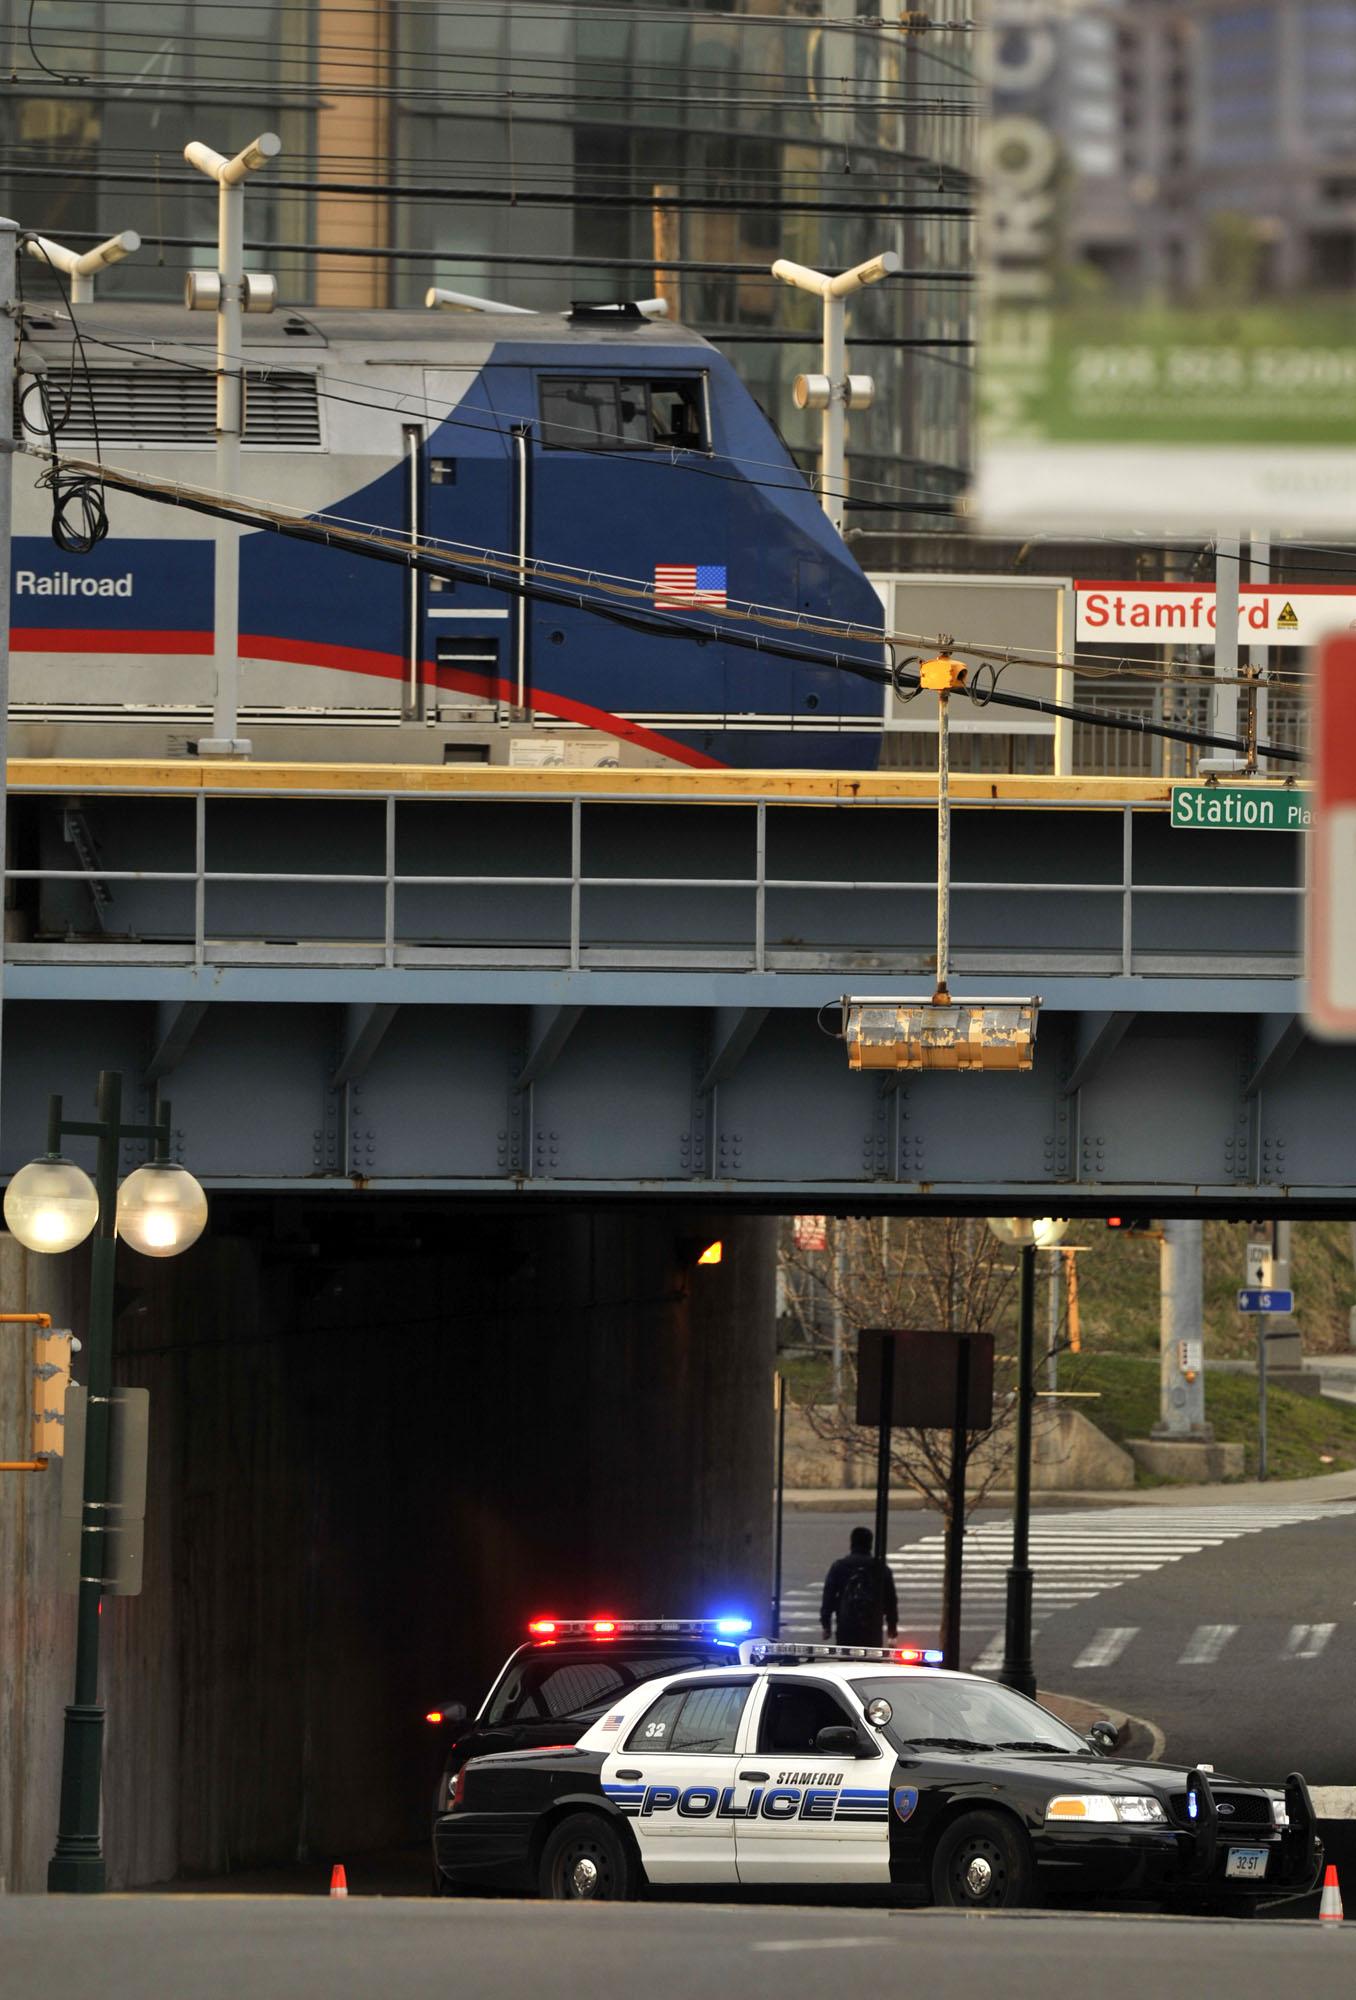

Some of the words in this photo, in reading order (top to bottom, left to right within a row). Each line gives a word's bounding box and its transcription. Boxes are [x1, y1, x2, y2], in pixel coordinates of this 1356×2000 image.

[16, 571, 132, 597] Railroad
[1177, 792, 1274, 823] Station
[645, 1722, 666, 1738] 32
[776, 1771, 844, 1786] STAMFORD
[640, 1785, 840, 1821] POLICE
